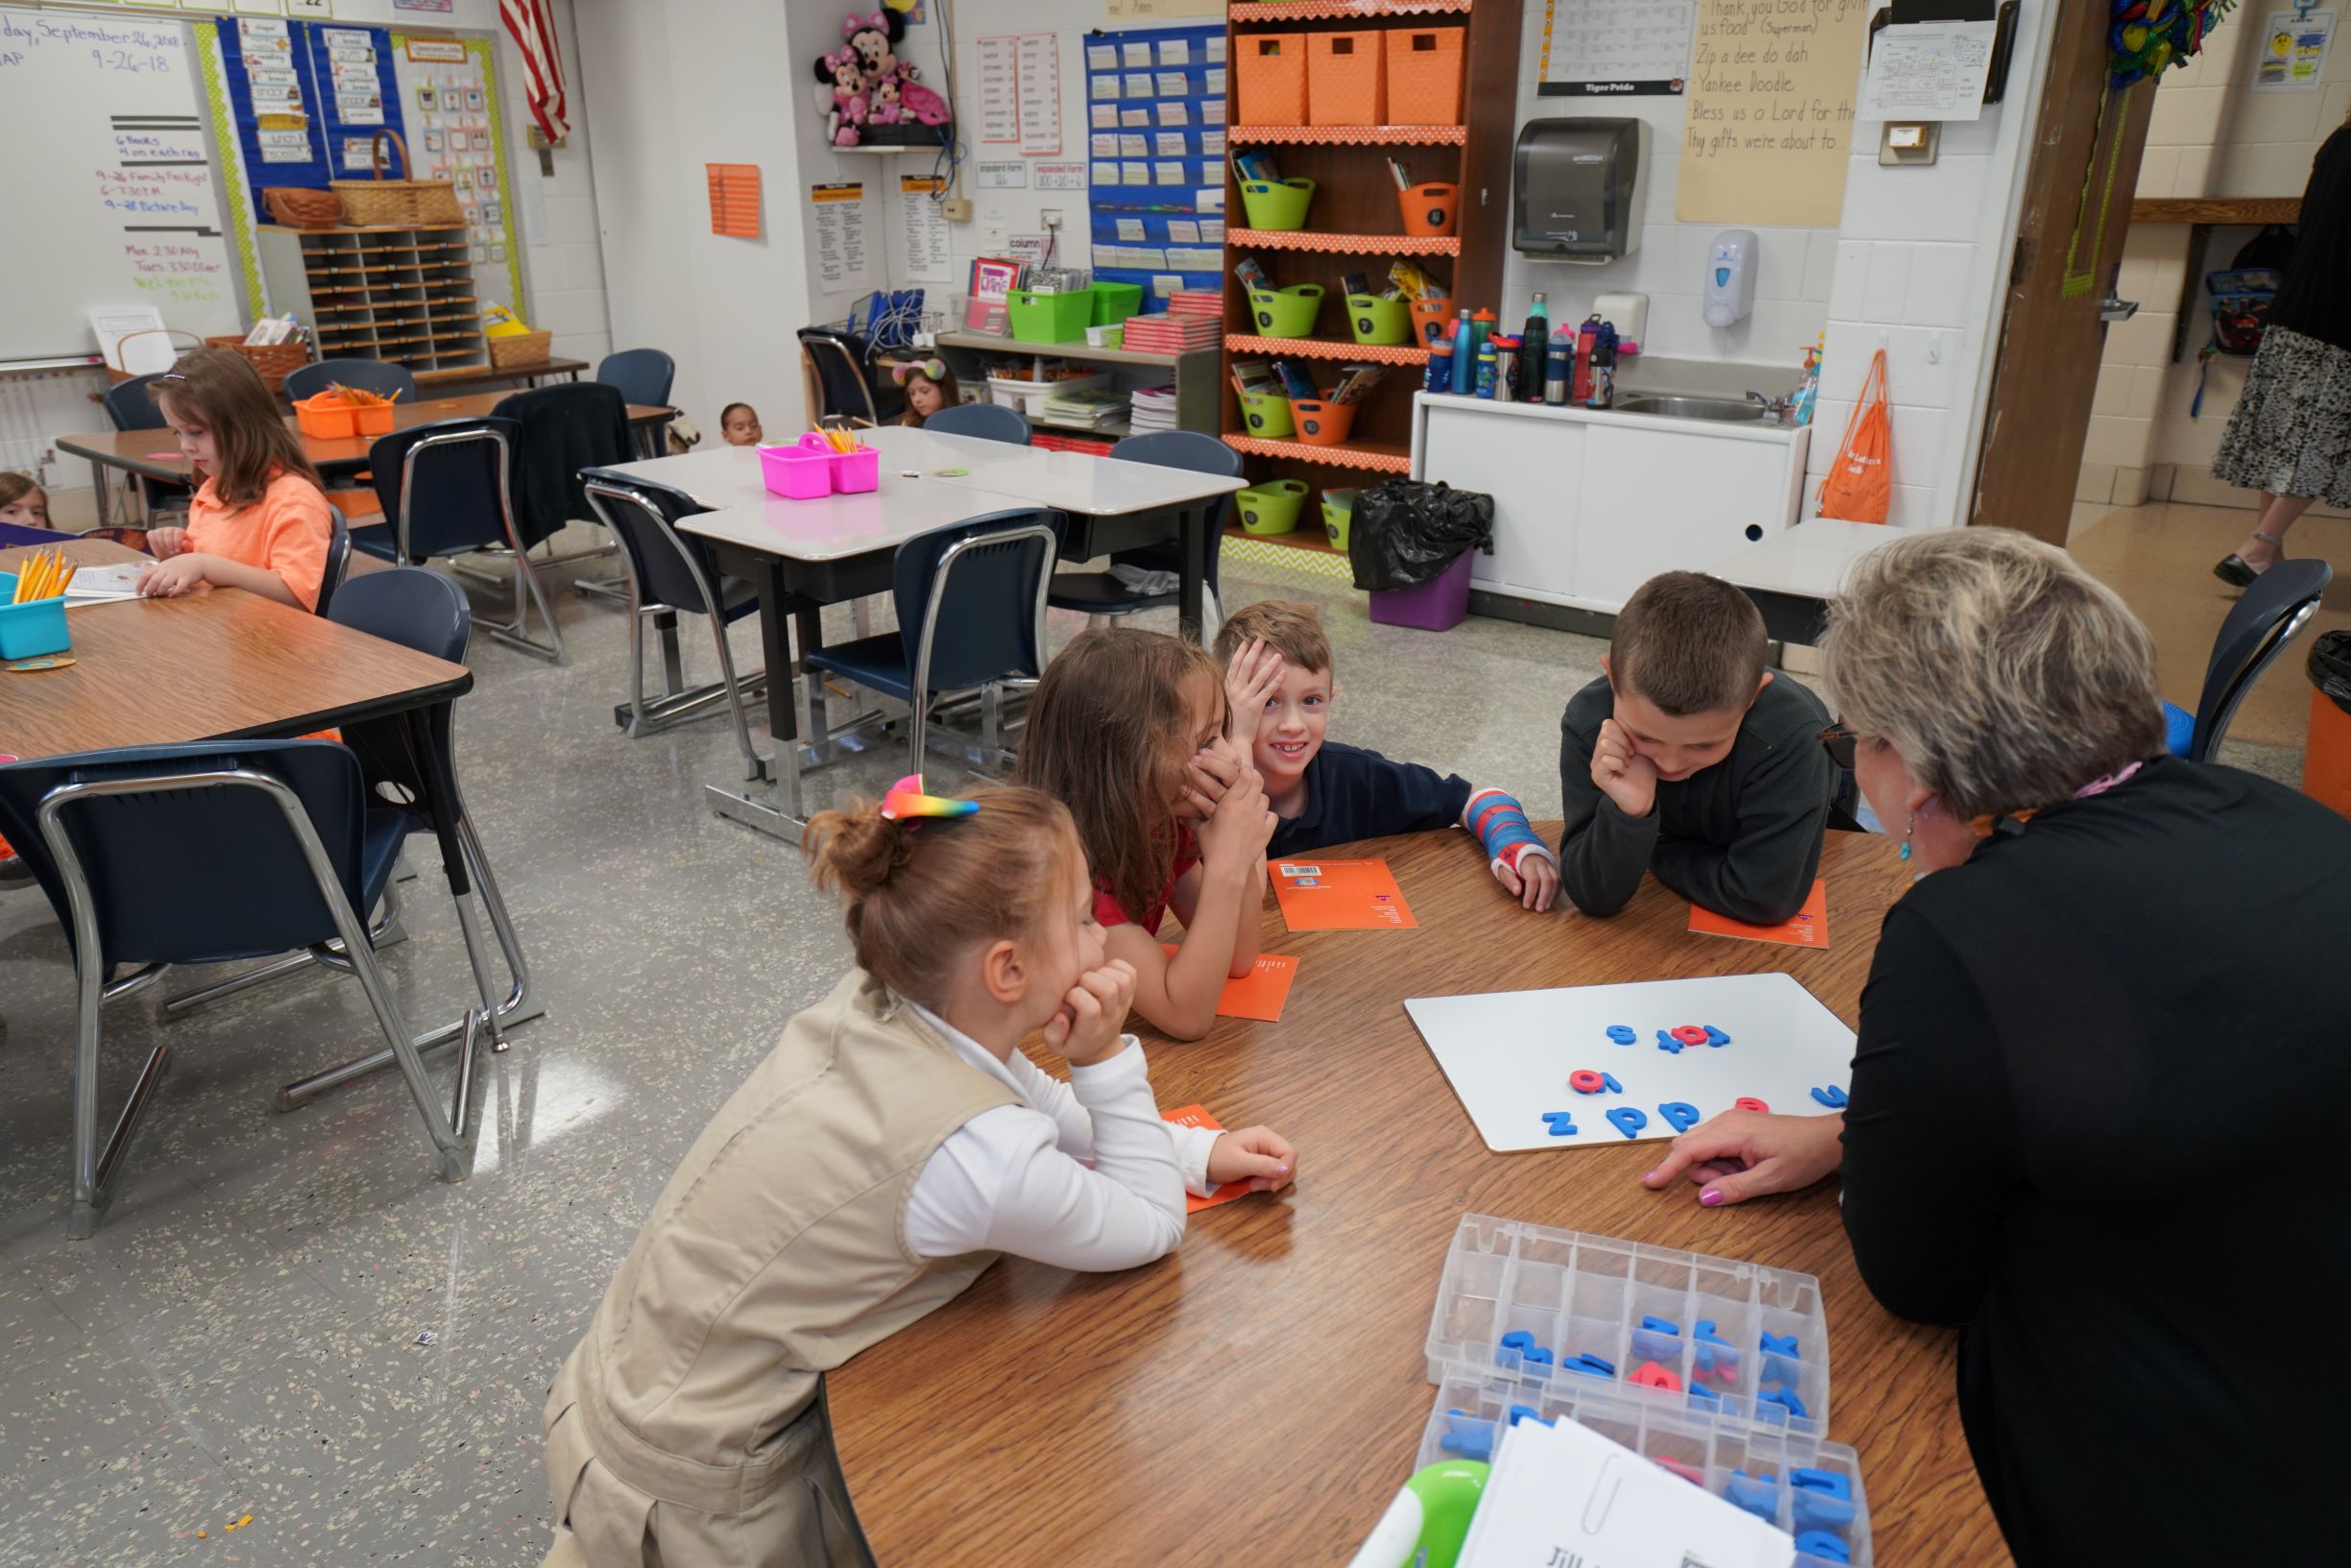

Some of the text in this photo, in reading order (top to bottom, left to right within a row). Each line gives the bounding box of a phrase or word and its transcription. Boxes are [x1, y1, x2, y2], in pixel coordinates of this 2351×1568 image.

[1752, 2, 1772, 24] you
[36, 19, 131, 44] September
[1701, 24, 1717, 36] us
[1719, 17, 1750, 36] food
[92, 49, 170, 73] 9-26-18
[1696, 41, 1809, 68] Zip a dee do dah
[1586, 83, 1635, 93] Tiger Pride
[1699, 70, 1795, 93] Yankee Doodle
[1692, 100, 1725, 122] Bless
[1733, 109, 1746, 121] us
[1772, 100, 1806, 122] Lord
[1812, 99, 1831, 121] for
[1687, 127, 1706, 158] Thy
[1709, 128, 1738, 158] gifts
[1781, 129, 1816, 150] about
[1009, 238, 1040, 249] column
[1361, 320, 1369, 331] 7
